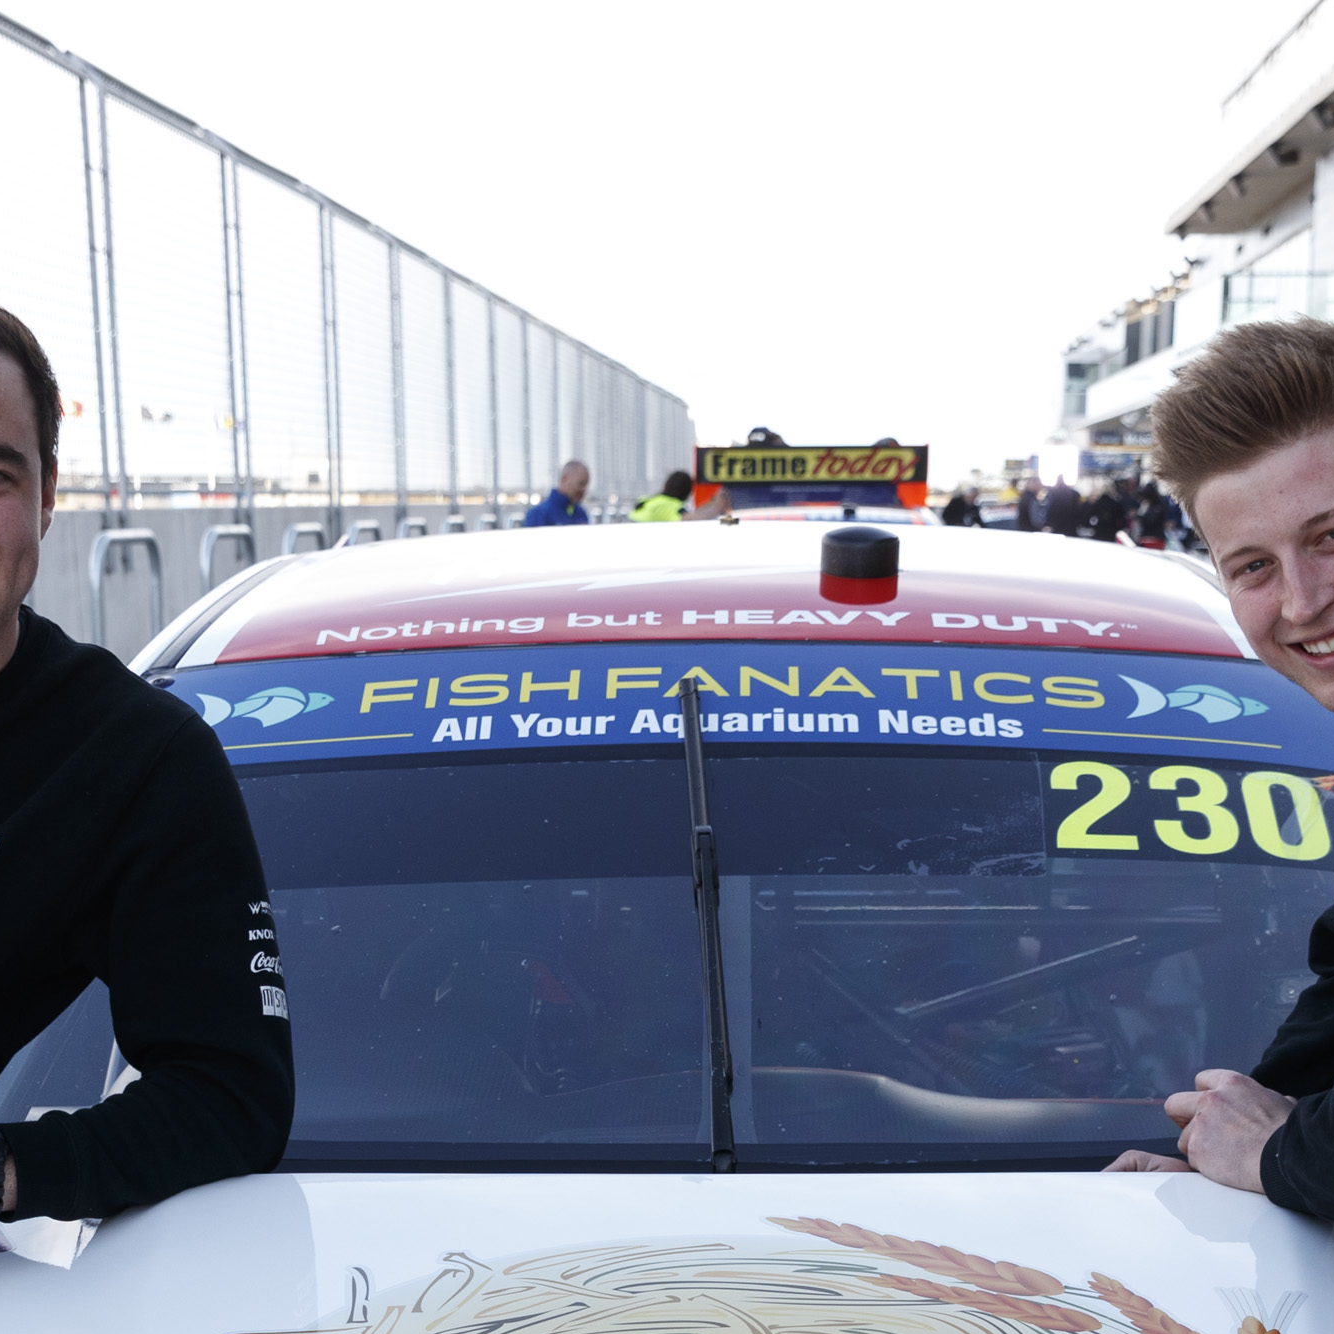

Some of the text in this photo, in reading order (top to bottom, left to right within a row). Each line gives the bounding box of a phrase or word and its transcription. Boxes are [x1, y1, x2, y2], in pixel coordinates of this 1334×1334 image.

[712, 448, 921, 484] Frame today
[316, 615, 546, 646] Nothing
[568, 610, 662, 628] but
[682, 609, 910, 626] HEAVY
[359, 665, 1105, 714] FISH FANATICS
[431, 708, 1024, 743] All Your Aquarium Needs
[1048, 761, 1332, 861] 230
